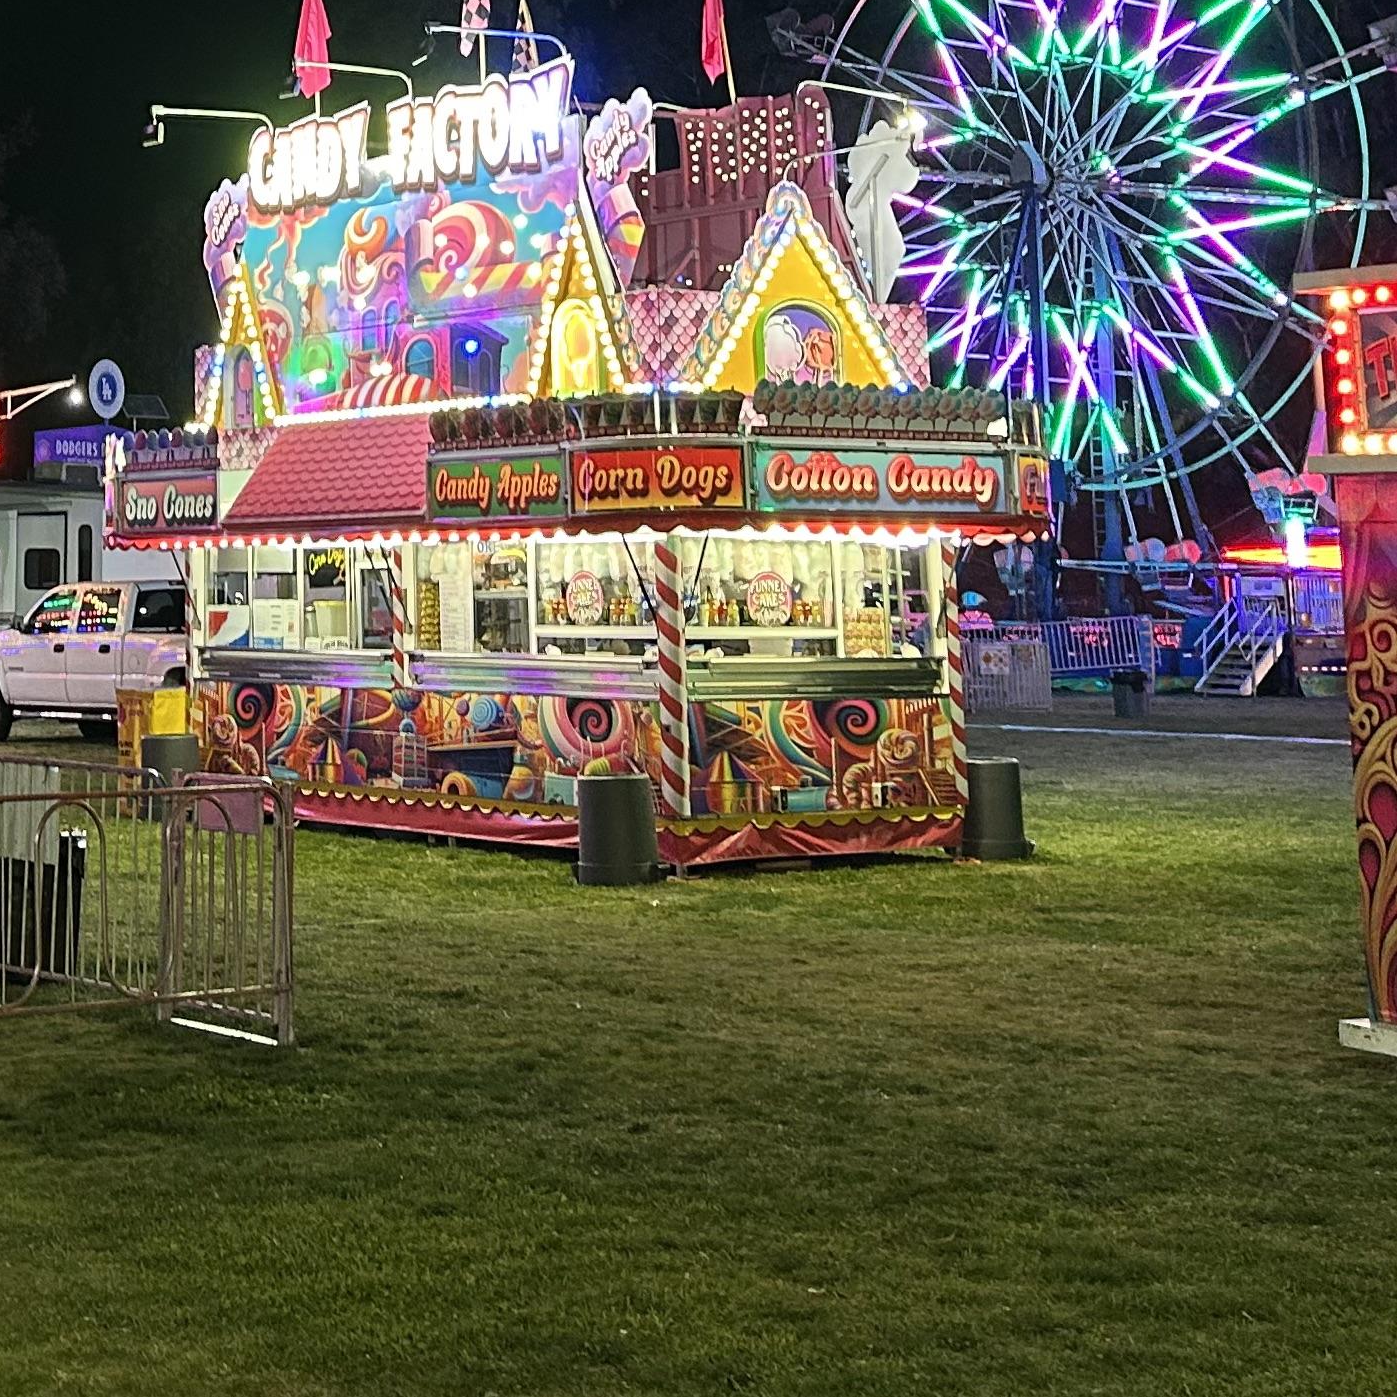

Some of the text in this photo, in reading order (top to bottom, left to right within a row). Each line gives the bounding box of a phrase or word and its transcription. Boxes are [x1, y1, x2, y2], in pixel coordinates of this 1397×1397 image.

[248, 62, 570, 213] CANDY FACTORY
[55, 439, 98, 457] DODGERS
[435, 461, 558, 510] Candy Apples
[578, 454, 730, 499] Corn Dogs
[766, 451, 996, 504] Cotton Candy
[124, 484, 214, 522] Sno Cones
[748, 579, 788, 594] FUNNEL
[752, 592, 786, 607] CAKES
